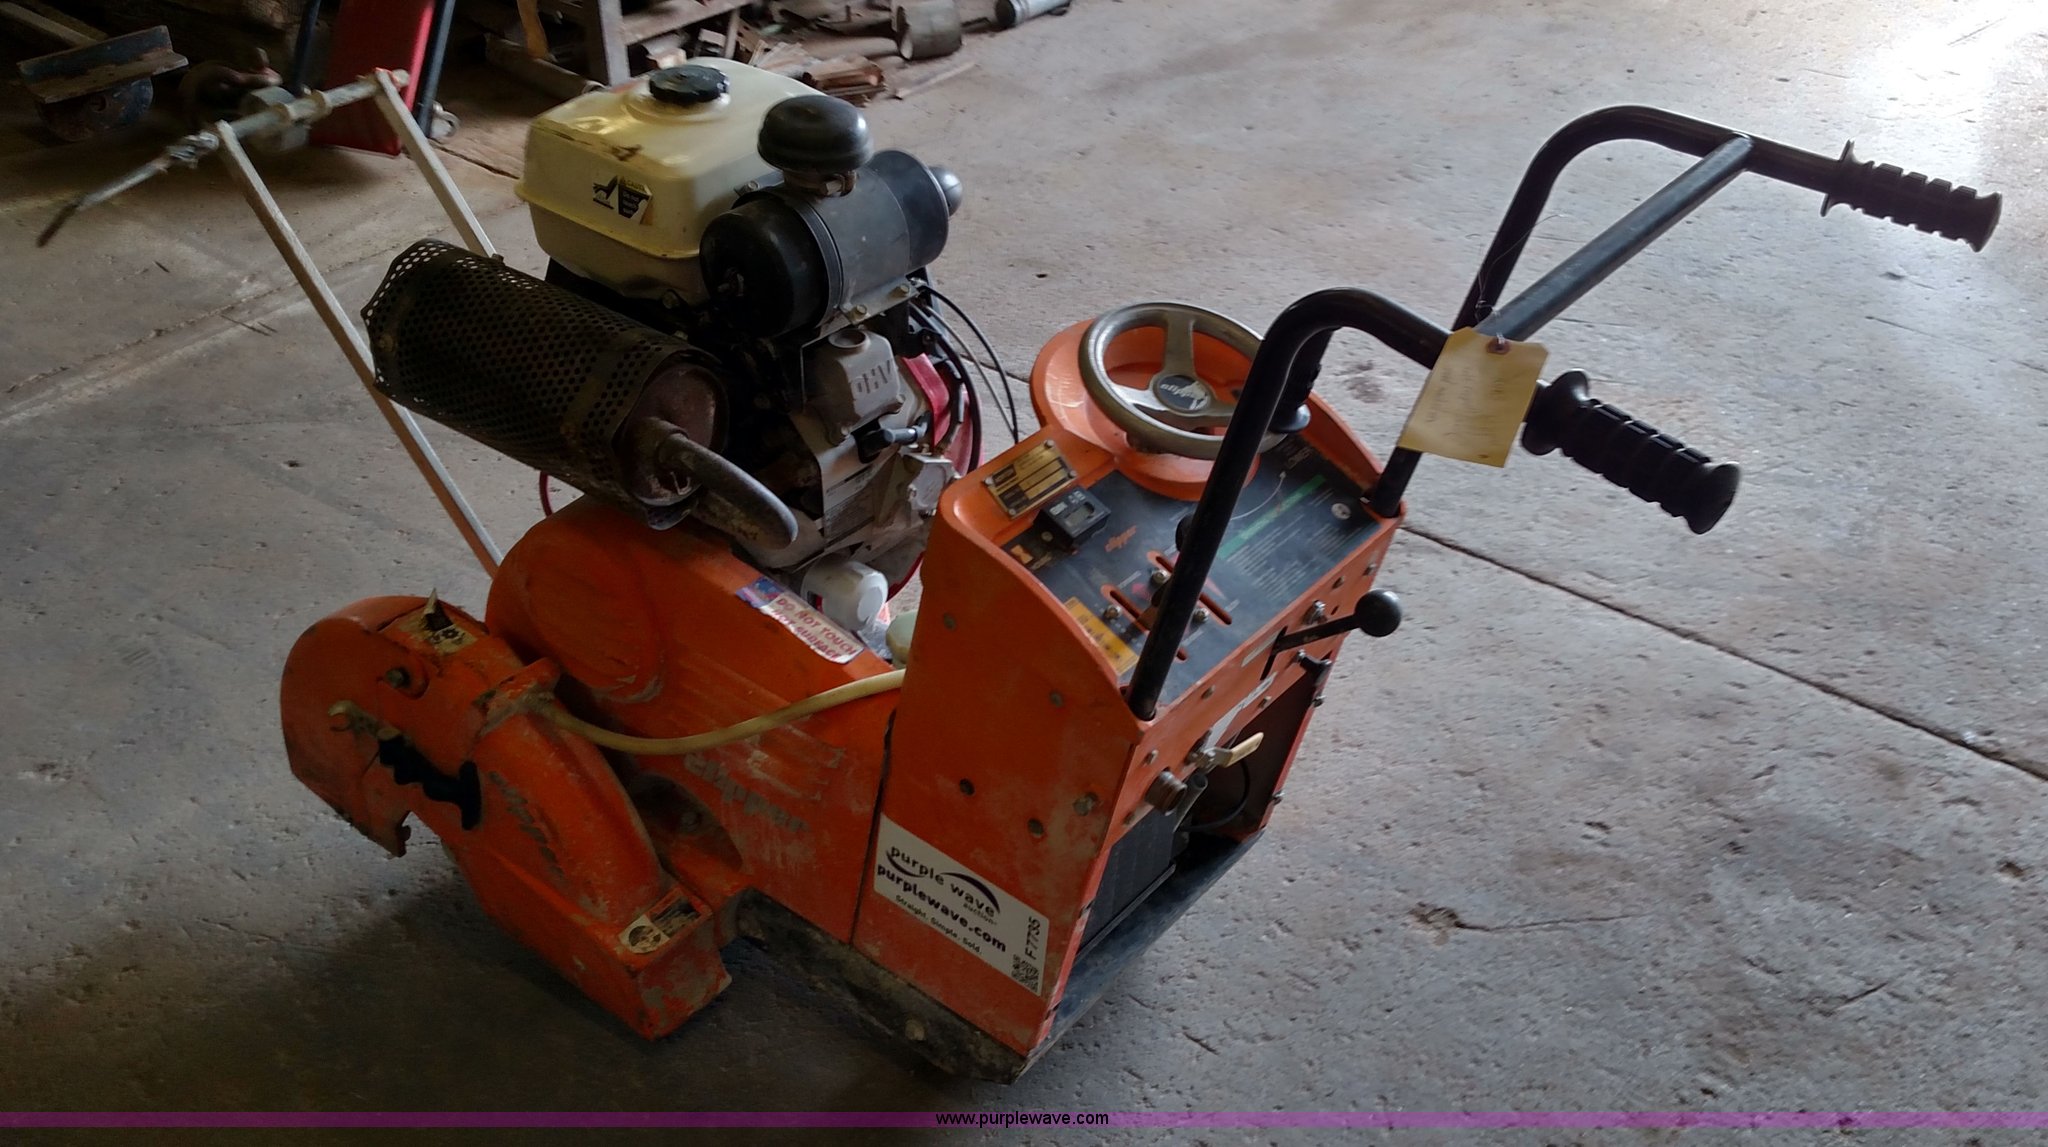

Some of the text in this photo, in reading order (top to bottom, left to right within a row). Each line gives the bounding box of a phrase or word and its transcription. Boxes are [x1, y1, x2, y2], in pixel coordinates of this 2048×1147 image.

[776, 598, 857, 655] DO NOT TOUCH
[877, 864, 1006, 952] purplewave.com
[890, 846, 995, 917] purple wave
